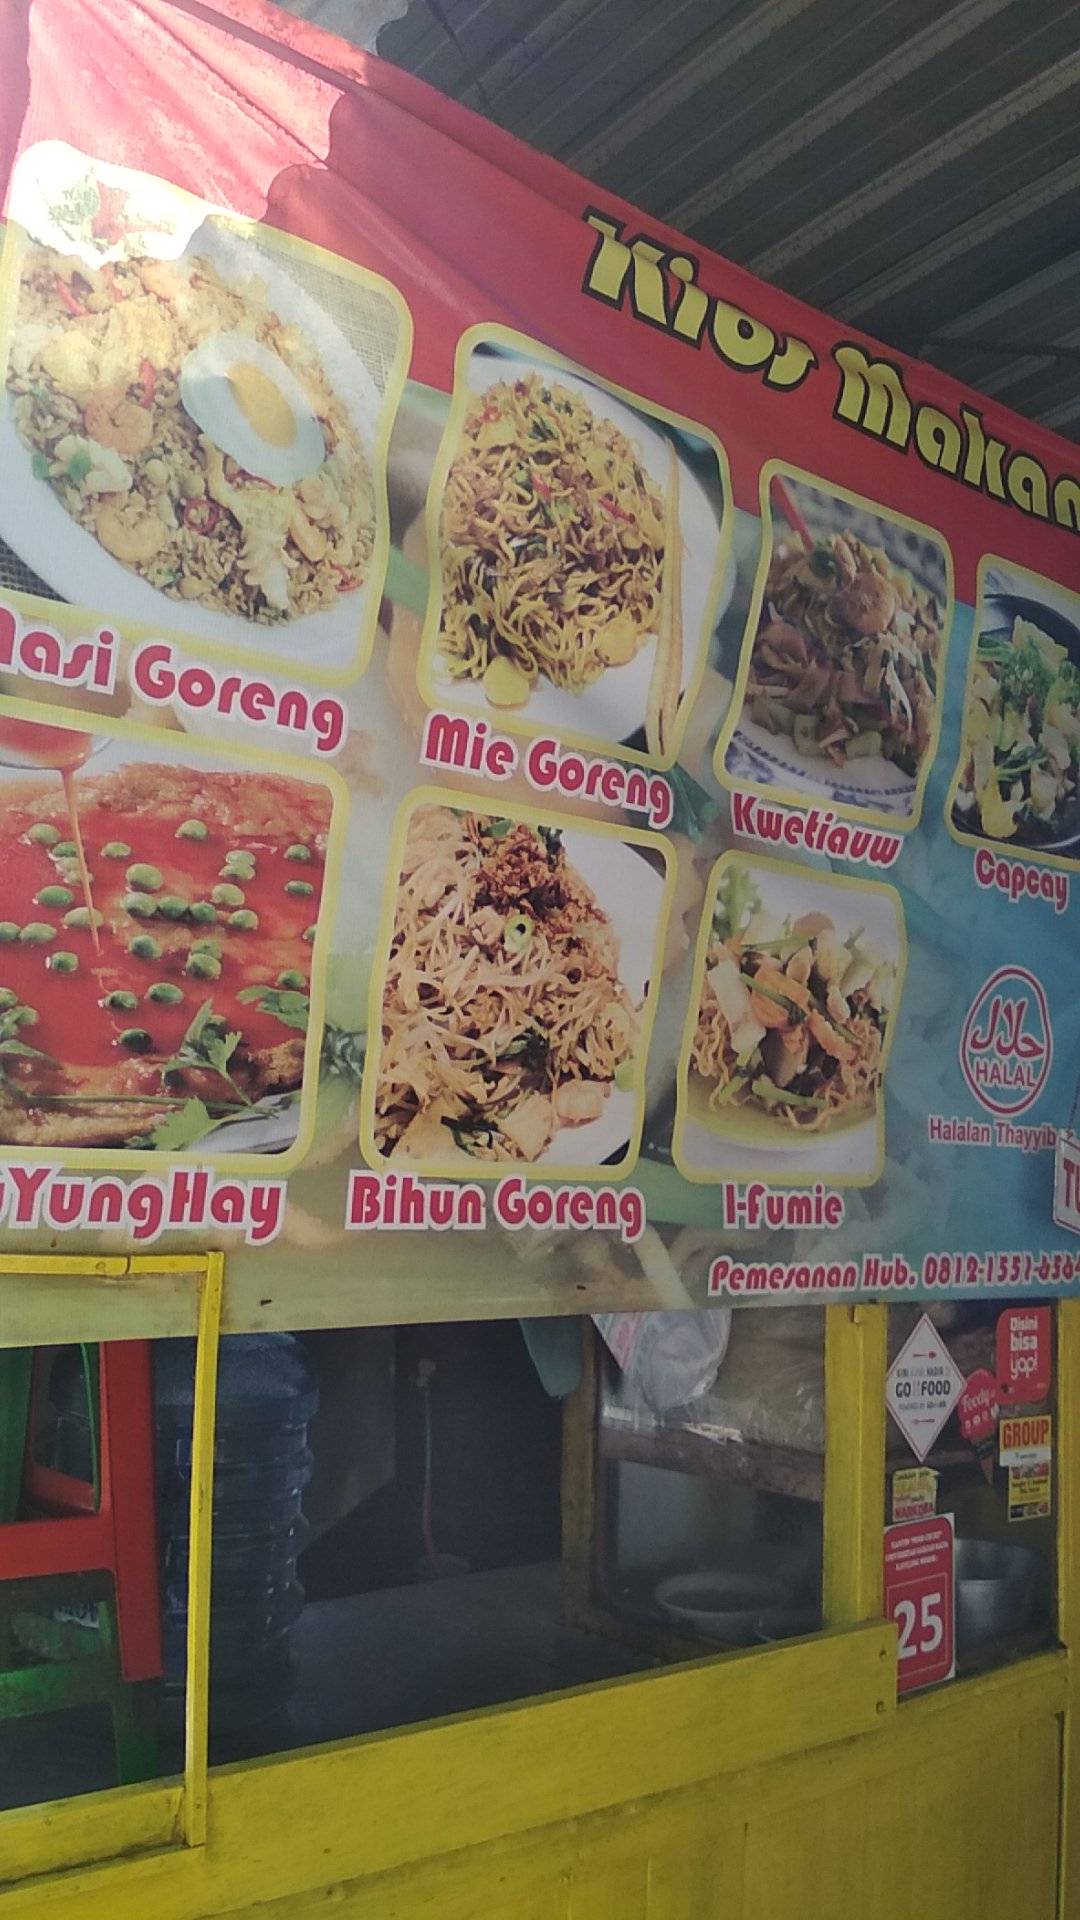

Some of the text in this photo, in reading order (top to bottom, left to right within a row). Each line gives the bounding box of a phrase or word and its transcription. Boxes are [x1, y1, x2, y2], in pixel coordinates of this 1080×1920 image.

[583, 206, 817, 390] Kios
[134, 644, 345, 752] Goreng
[424, 712, 671, 825] Mie Goreng
[732, 792, 900, 865] Kwetiauw
[974, 849, 1068, 911] Capcay
[969, 997, 1046, 1059] حلال
[974, 1059, 1037, 1087] HALAL
[929, 1116, 1057, 1150] Halalan Thayyib
[0, 1167, 282, 1240] YungHay
[349, 1174, 645, 1238] Bihun Goreng
[710, 1258, 857, 1291] Pemesanan
[864, 1256, 917, 1287] Hub.
[1010, 1331, 1038, 1351] bisa
[895, 1379, 951, 1398] GO FOOD
[1002, 1418, 1049, 1449] GROUP
[893, 1591, 943, 1659] 25
